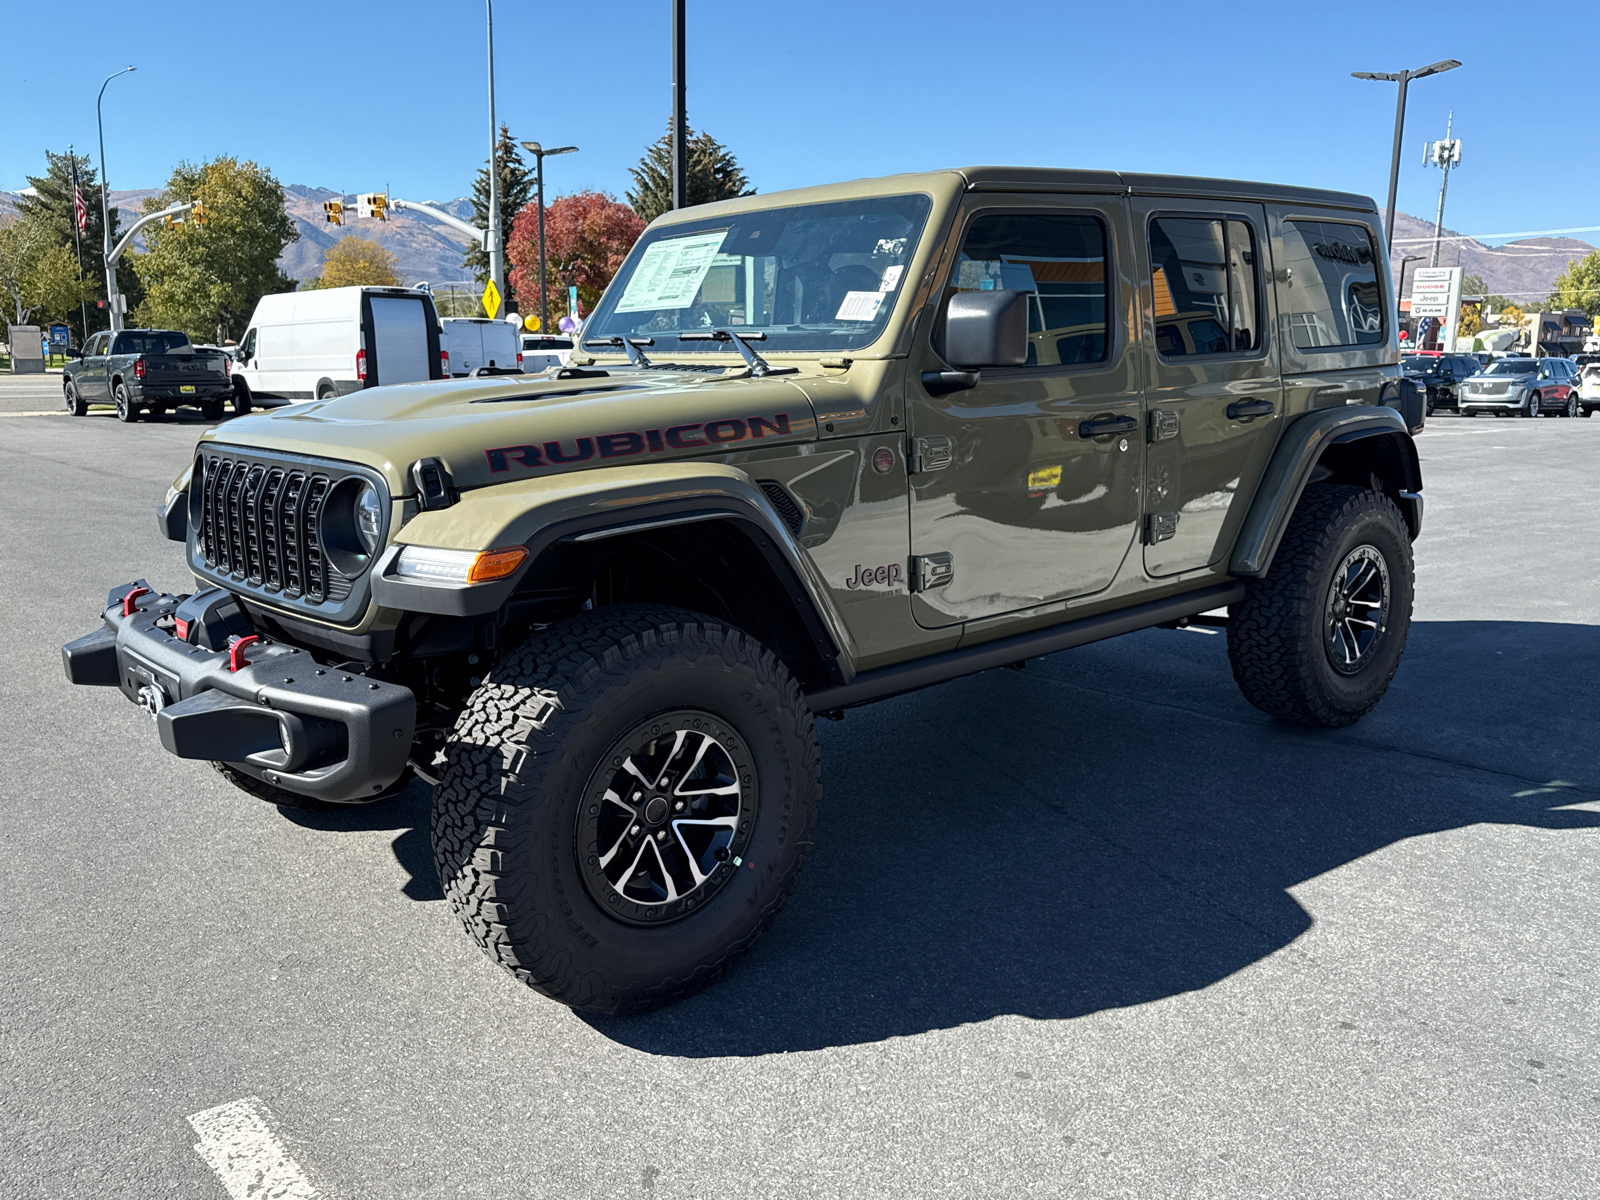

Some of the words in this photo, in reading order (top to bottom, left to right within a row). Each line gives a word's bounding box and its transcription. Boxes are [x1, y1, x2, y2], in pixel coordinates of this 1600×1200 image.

[1420, 294, 1439, 303] Jeep
[483, 412, 793, 474] RUBICON
[843, 590, 894, 605] WRANGLER
[845, 563, 902, 590] Jeep
[734, 688, 794, 850] All-Terrain
[550, 750, 599, 949] BFGoodrich
